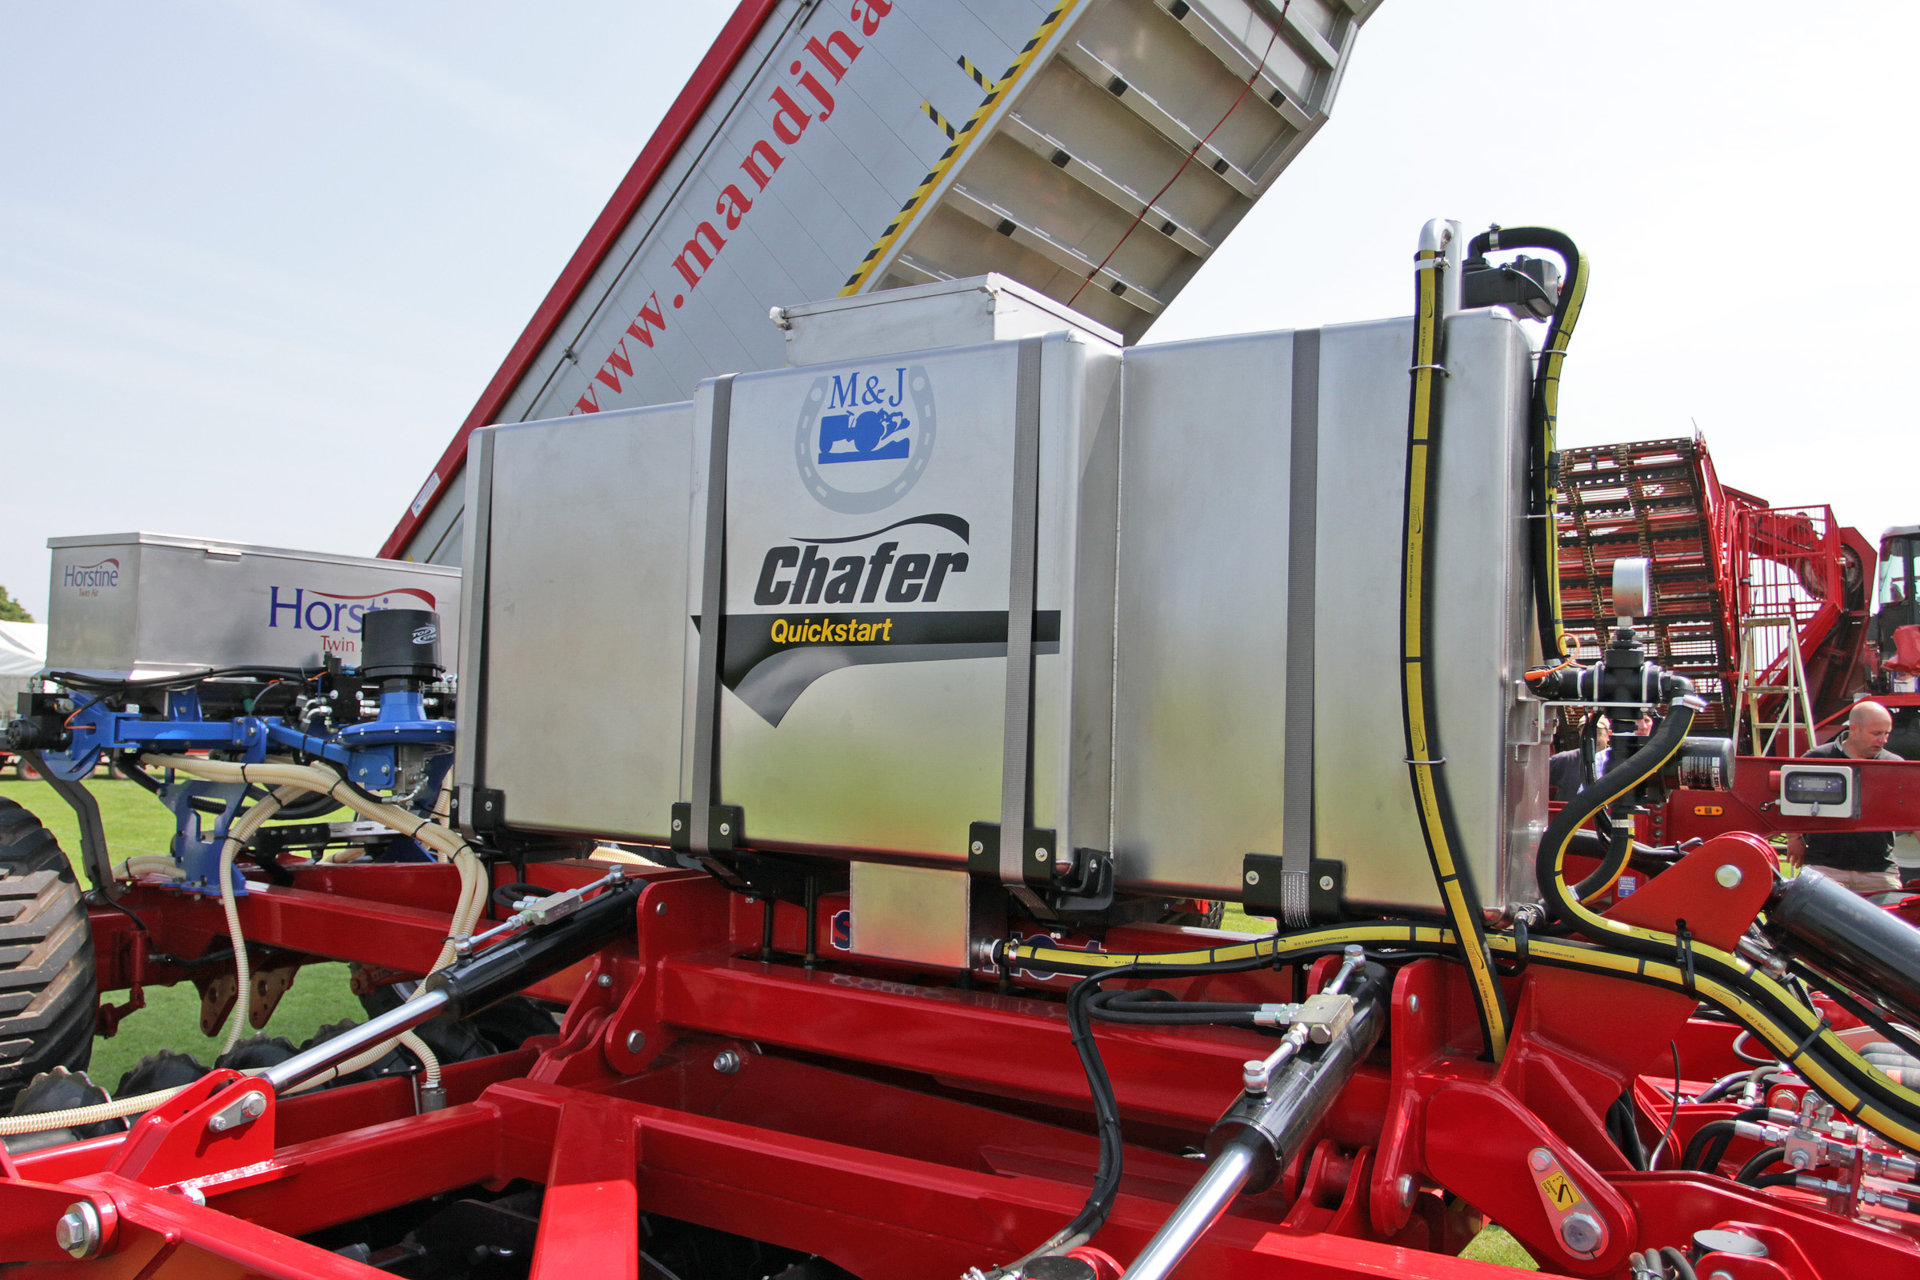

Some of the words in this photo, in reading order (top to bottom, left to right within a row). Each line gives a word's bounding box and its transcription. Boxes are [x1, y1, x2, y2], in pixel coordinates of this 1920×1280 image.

[827, 367, 907, 410] M&J
[64, 565, 119, 587] Horstine
[753, 541, 969, 606] Chafer
[320, 634, 355, 652] Twin
[770, 617, 893, 644] Quickstart
